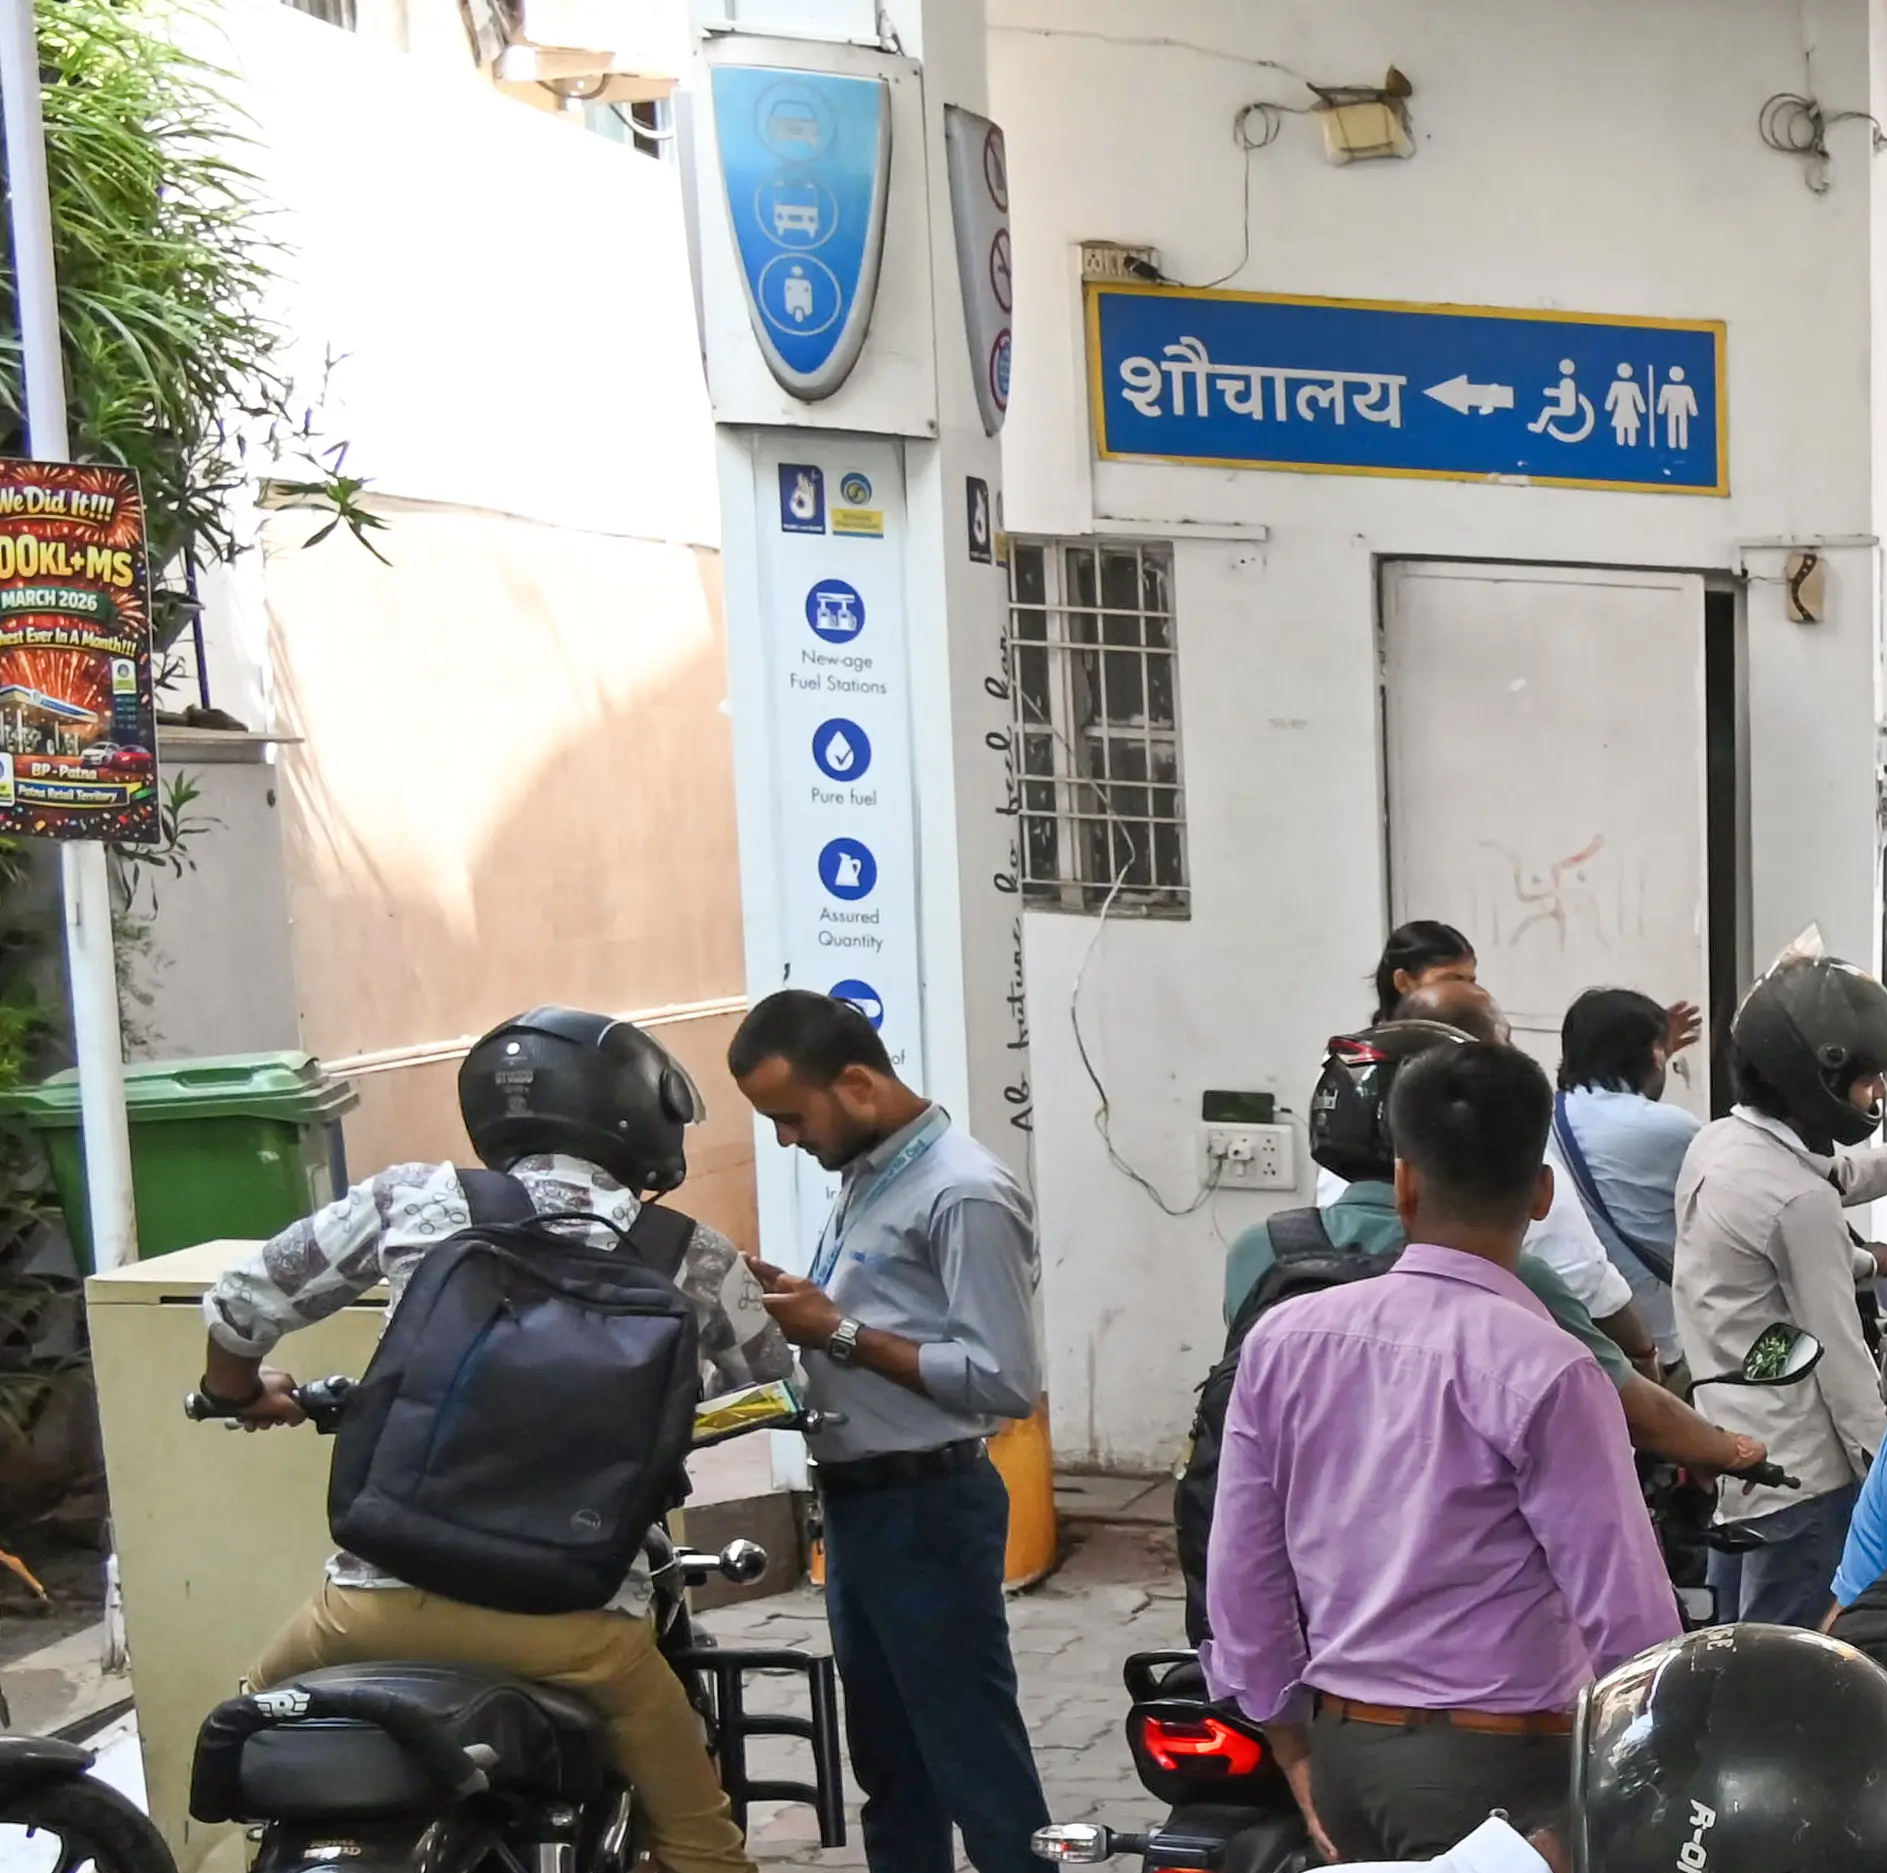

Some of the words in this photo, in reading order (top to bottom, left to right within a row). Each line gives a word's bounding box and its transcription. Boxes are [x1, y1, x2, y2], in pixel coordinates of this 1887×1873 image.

[1119, 335, 1407, 429] शौचालय
[23, 486, 66, 514] Did
[71, 491, 115, 521] It!!!
[0, 534, 134, 587] 00KL+MS
[1, 589, 56, 608] MARCH
[60, 590, 98, 611] 2026
[25, 626, 53, 643] Ever
[55, 627, 66, 643] In
[69, 630, 79, 644] A
[801, 649, 873, 672] New-age
[790, 673, 821, 692] Fuel
[827, 675, 887, 695] Stations
[31, 763, 50, 777] BP
[811, 787, 844, 805] Pure
[850, 788, 877, 806] fuel
[819, 908, 880, 925] Assured
[818, 931, 883, 953] Quantity
